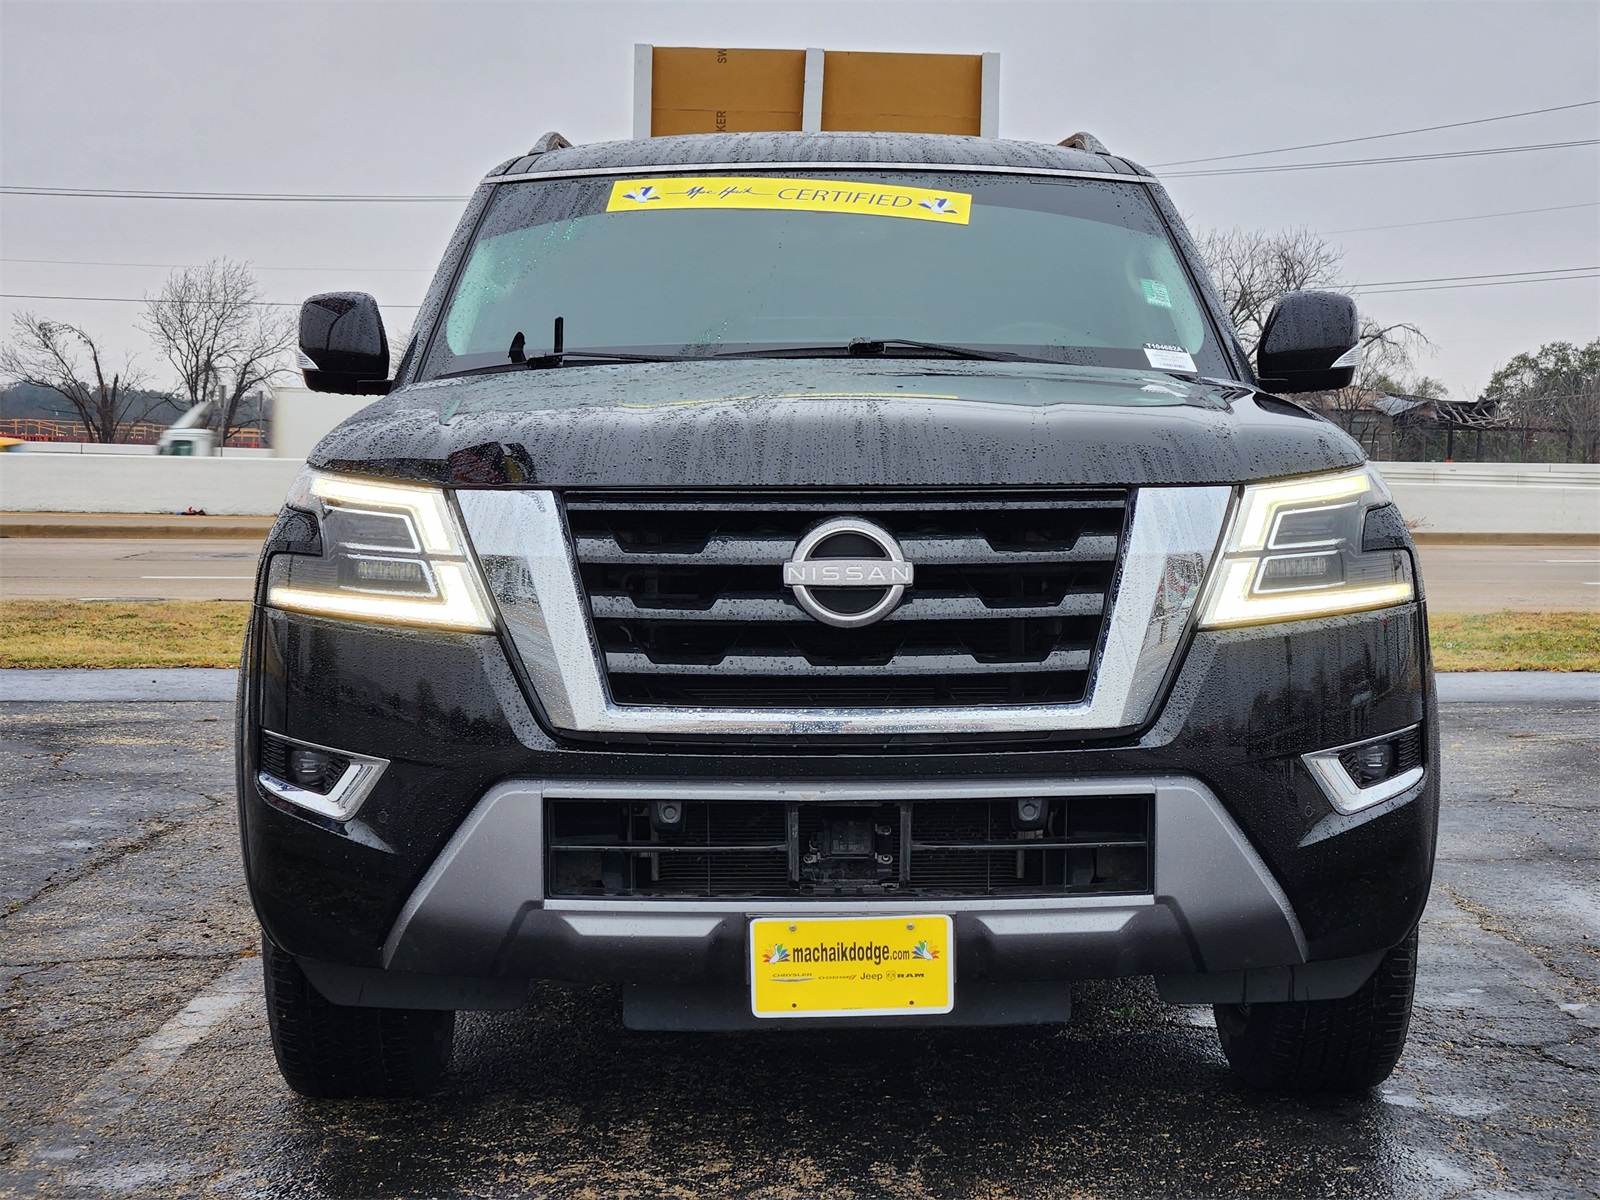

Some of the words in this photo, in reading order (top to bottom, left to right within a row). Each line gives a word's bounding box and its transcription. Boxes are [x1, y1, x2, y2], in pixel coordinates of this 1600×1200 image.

[716, 110, 726, 132] KER
[777, 187, 913, 208] CERTIFIED
[788, 566, 909, 581] NISSAN
[792, 941, 910, 965] machaikdodge.com
[860, 972, 883, 981] Jeep
